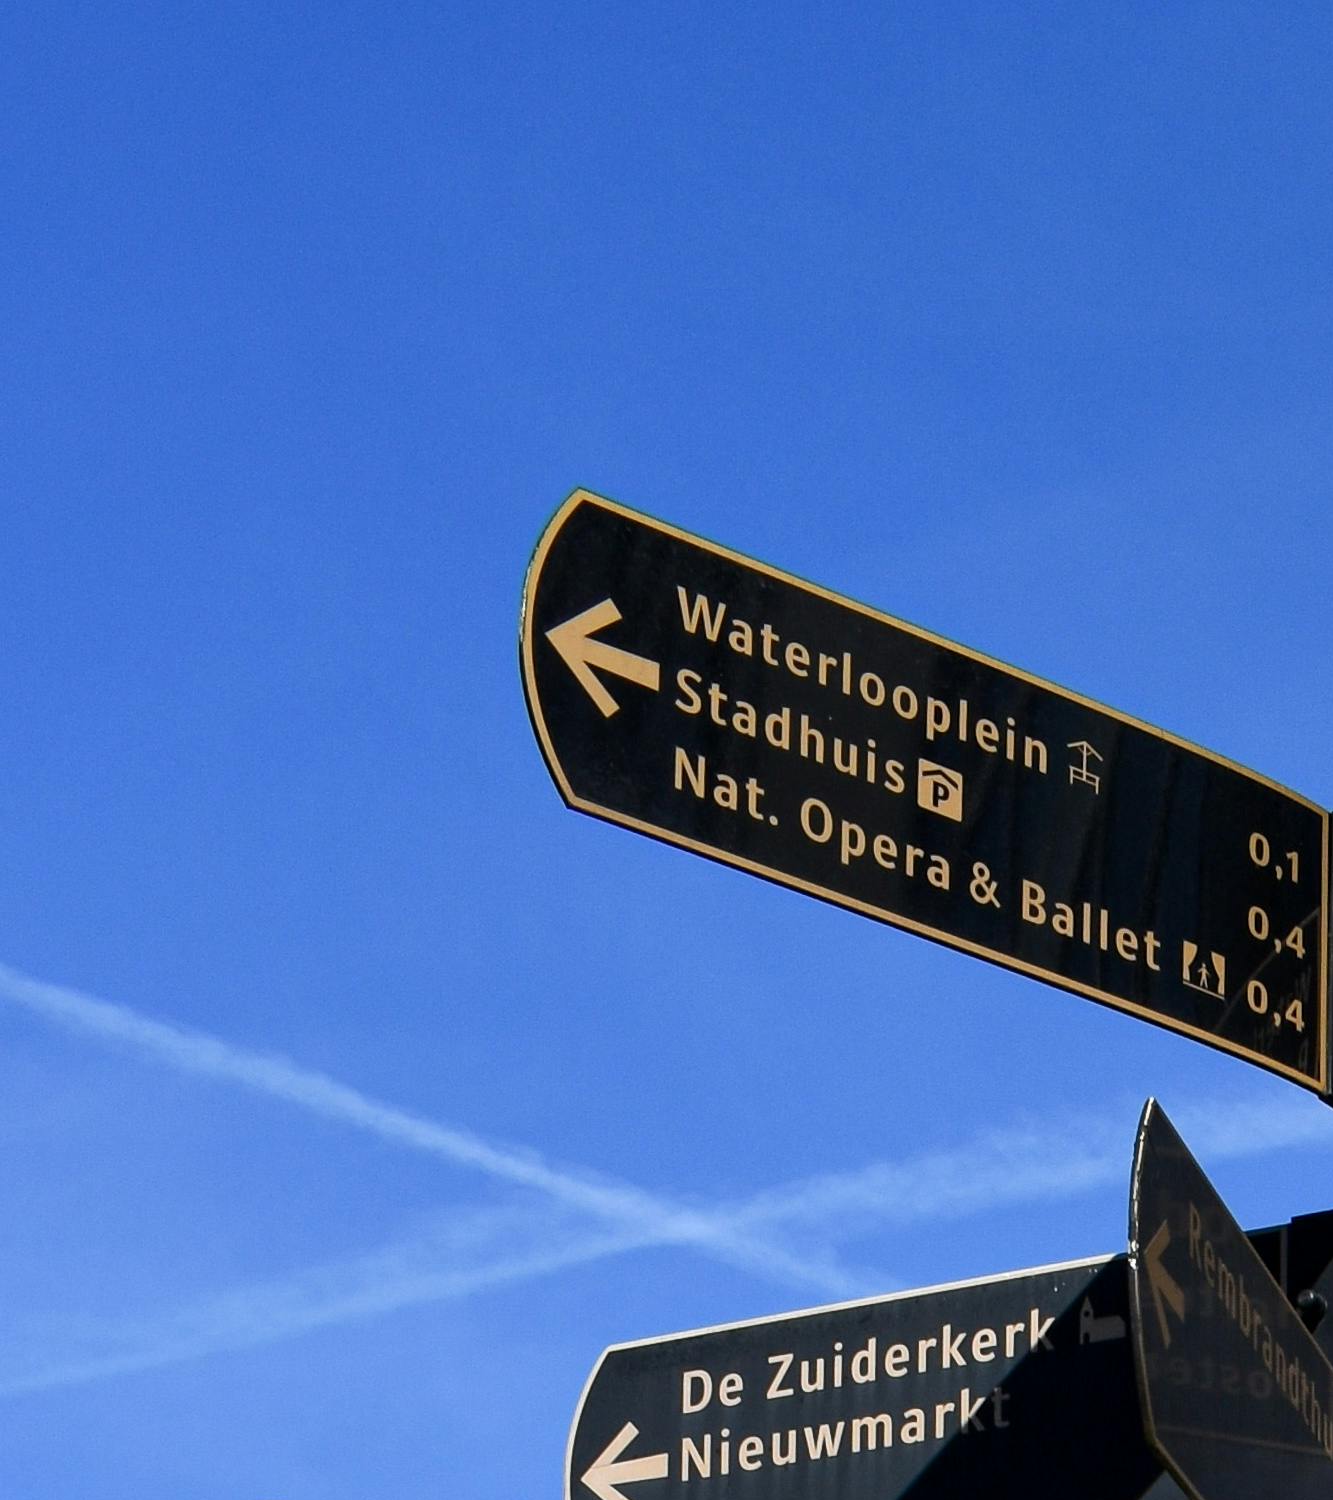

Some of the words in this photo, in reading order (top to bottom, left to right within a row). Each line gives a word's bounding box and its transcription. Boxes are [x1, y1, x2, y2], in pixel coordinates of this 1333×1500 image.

[676, 585, 1049, 774] Waterlooplein
[1249, 832, 1300, 884] 0,1
[676, 671, 906, 794] Stadhuis
[1248, 907, 1306, 959] 0,4
[674, 747, 779, 827] Nat.
[800, 798, 950, 890] Opera
[970, 862, 1000, 909] &
[1021, 880, 1161, 972] Ballet
[1246, 981, 1305, 1032] 0,4
[680, 1386, 1011, 1484] Nieuwmarkt
[681, 1368, 744, 1415] De
[767, 1308, 1056, 1400] Zuiderkerk
